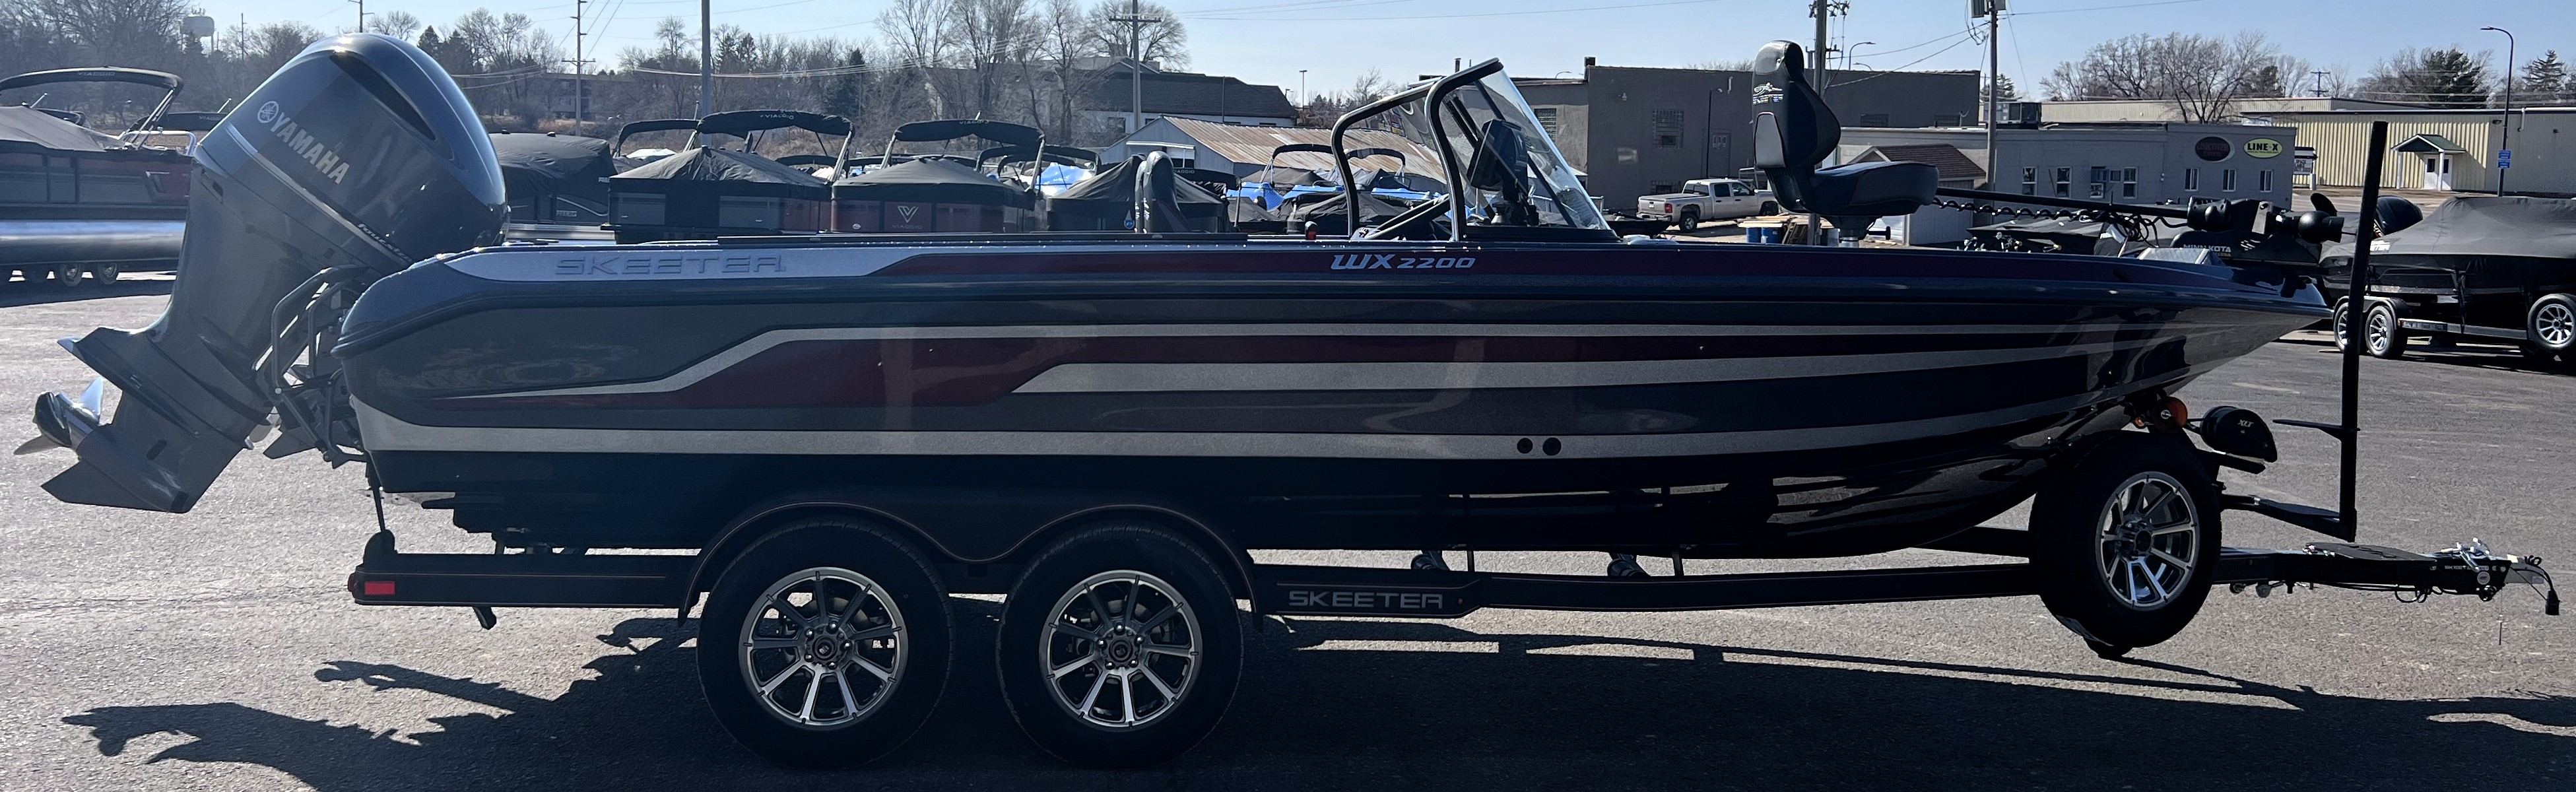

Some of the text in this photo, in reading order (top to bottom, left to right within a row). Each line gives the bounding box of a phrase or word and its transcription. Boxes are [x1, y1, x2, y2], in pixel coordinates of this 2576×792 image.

[270, 112, 350, 185] YAMAHA
[555, 255, 781, 275] SKEETER
[1331, 253, 1476, 270] WX 2200
[2237, 419, 2255, 428] XLT
[1288, 591, 1443, 610] SKEETER
